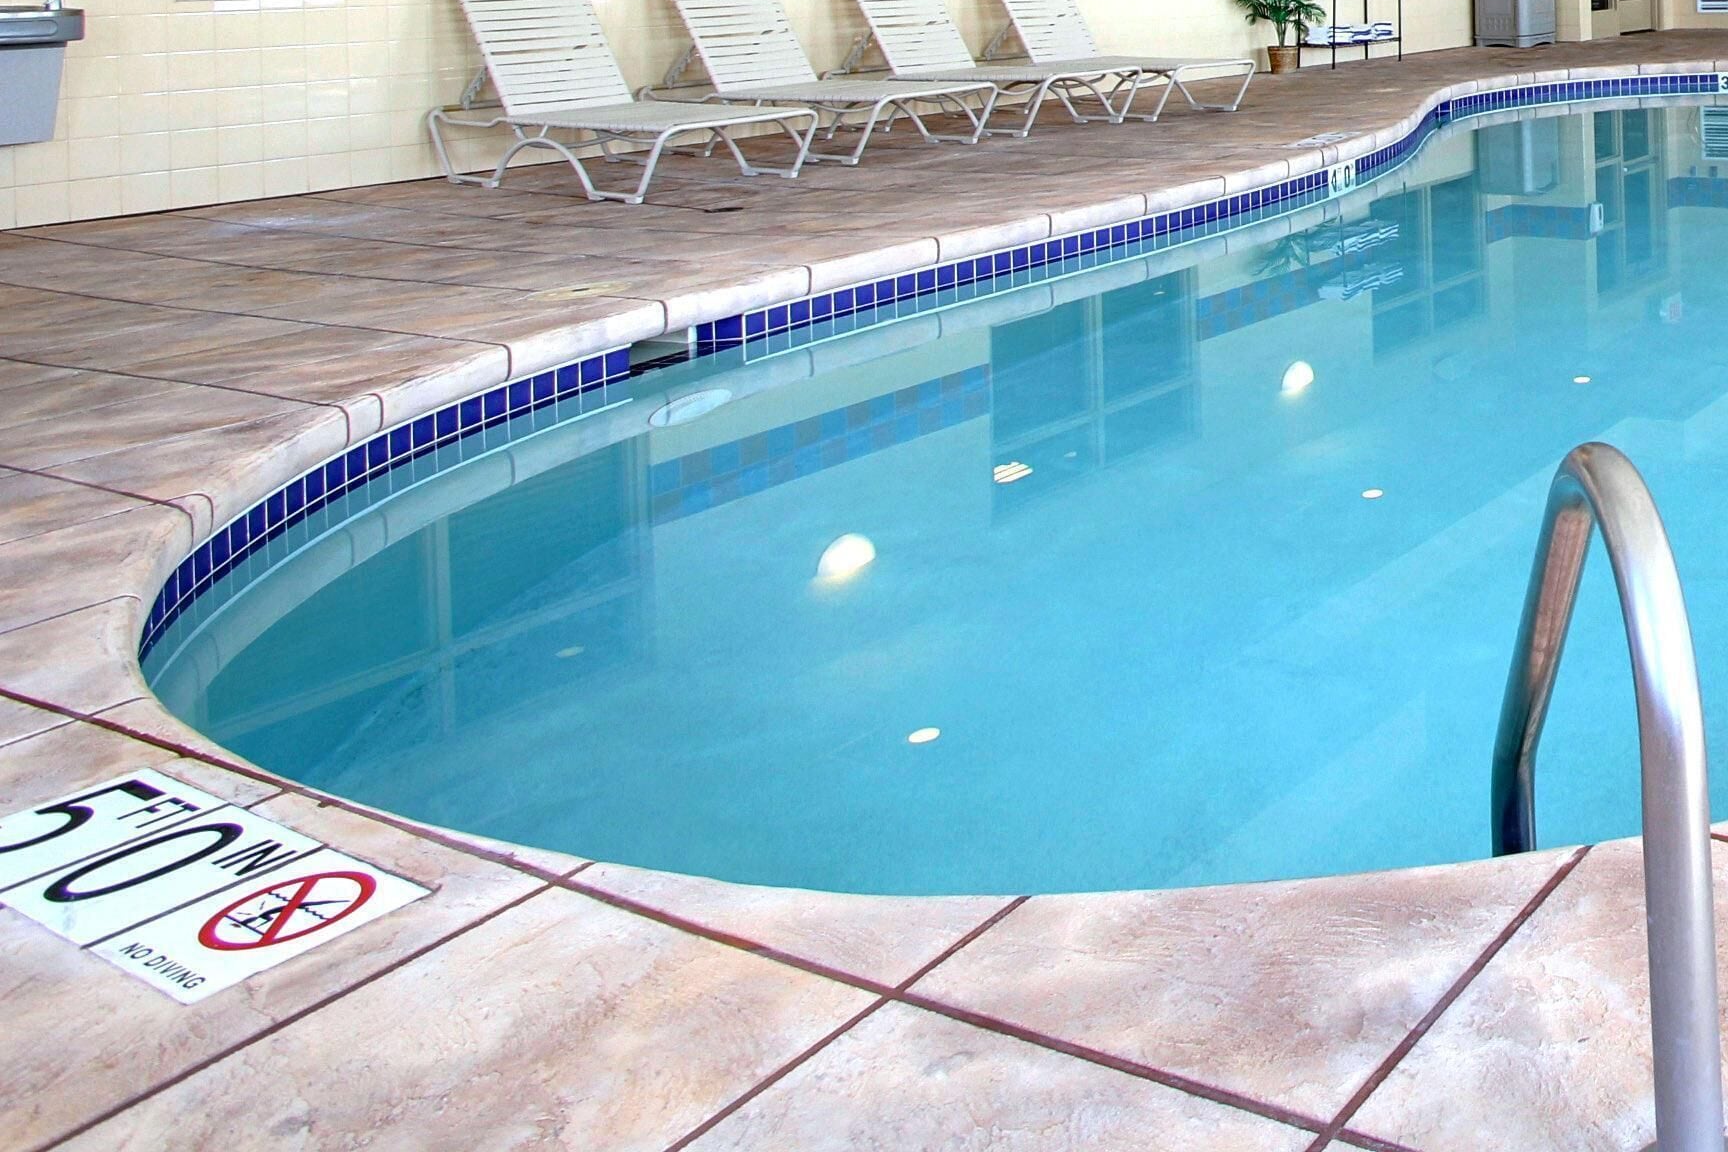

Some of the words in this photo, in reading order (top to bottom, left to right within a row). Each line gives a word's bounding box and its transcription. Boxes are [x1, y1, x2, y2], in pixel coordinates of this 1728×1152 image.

[0, 779, 167, 854] 5
[117, 797, 200, 829] FT
[43, 822, 244, 903] 0
[212, 839, 297, 877] IN
[120, 942, 149, 963] NO
[142, 956, 206, 990] DIVING
